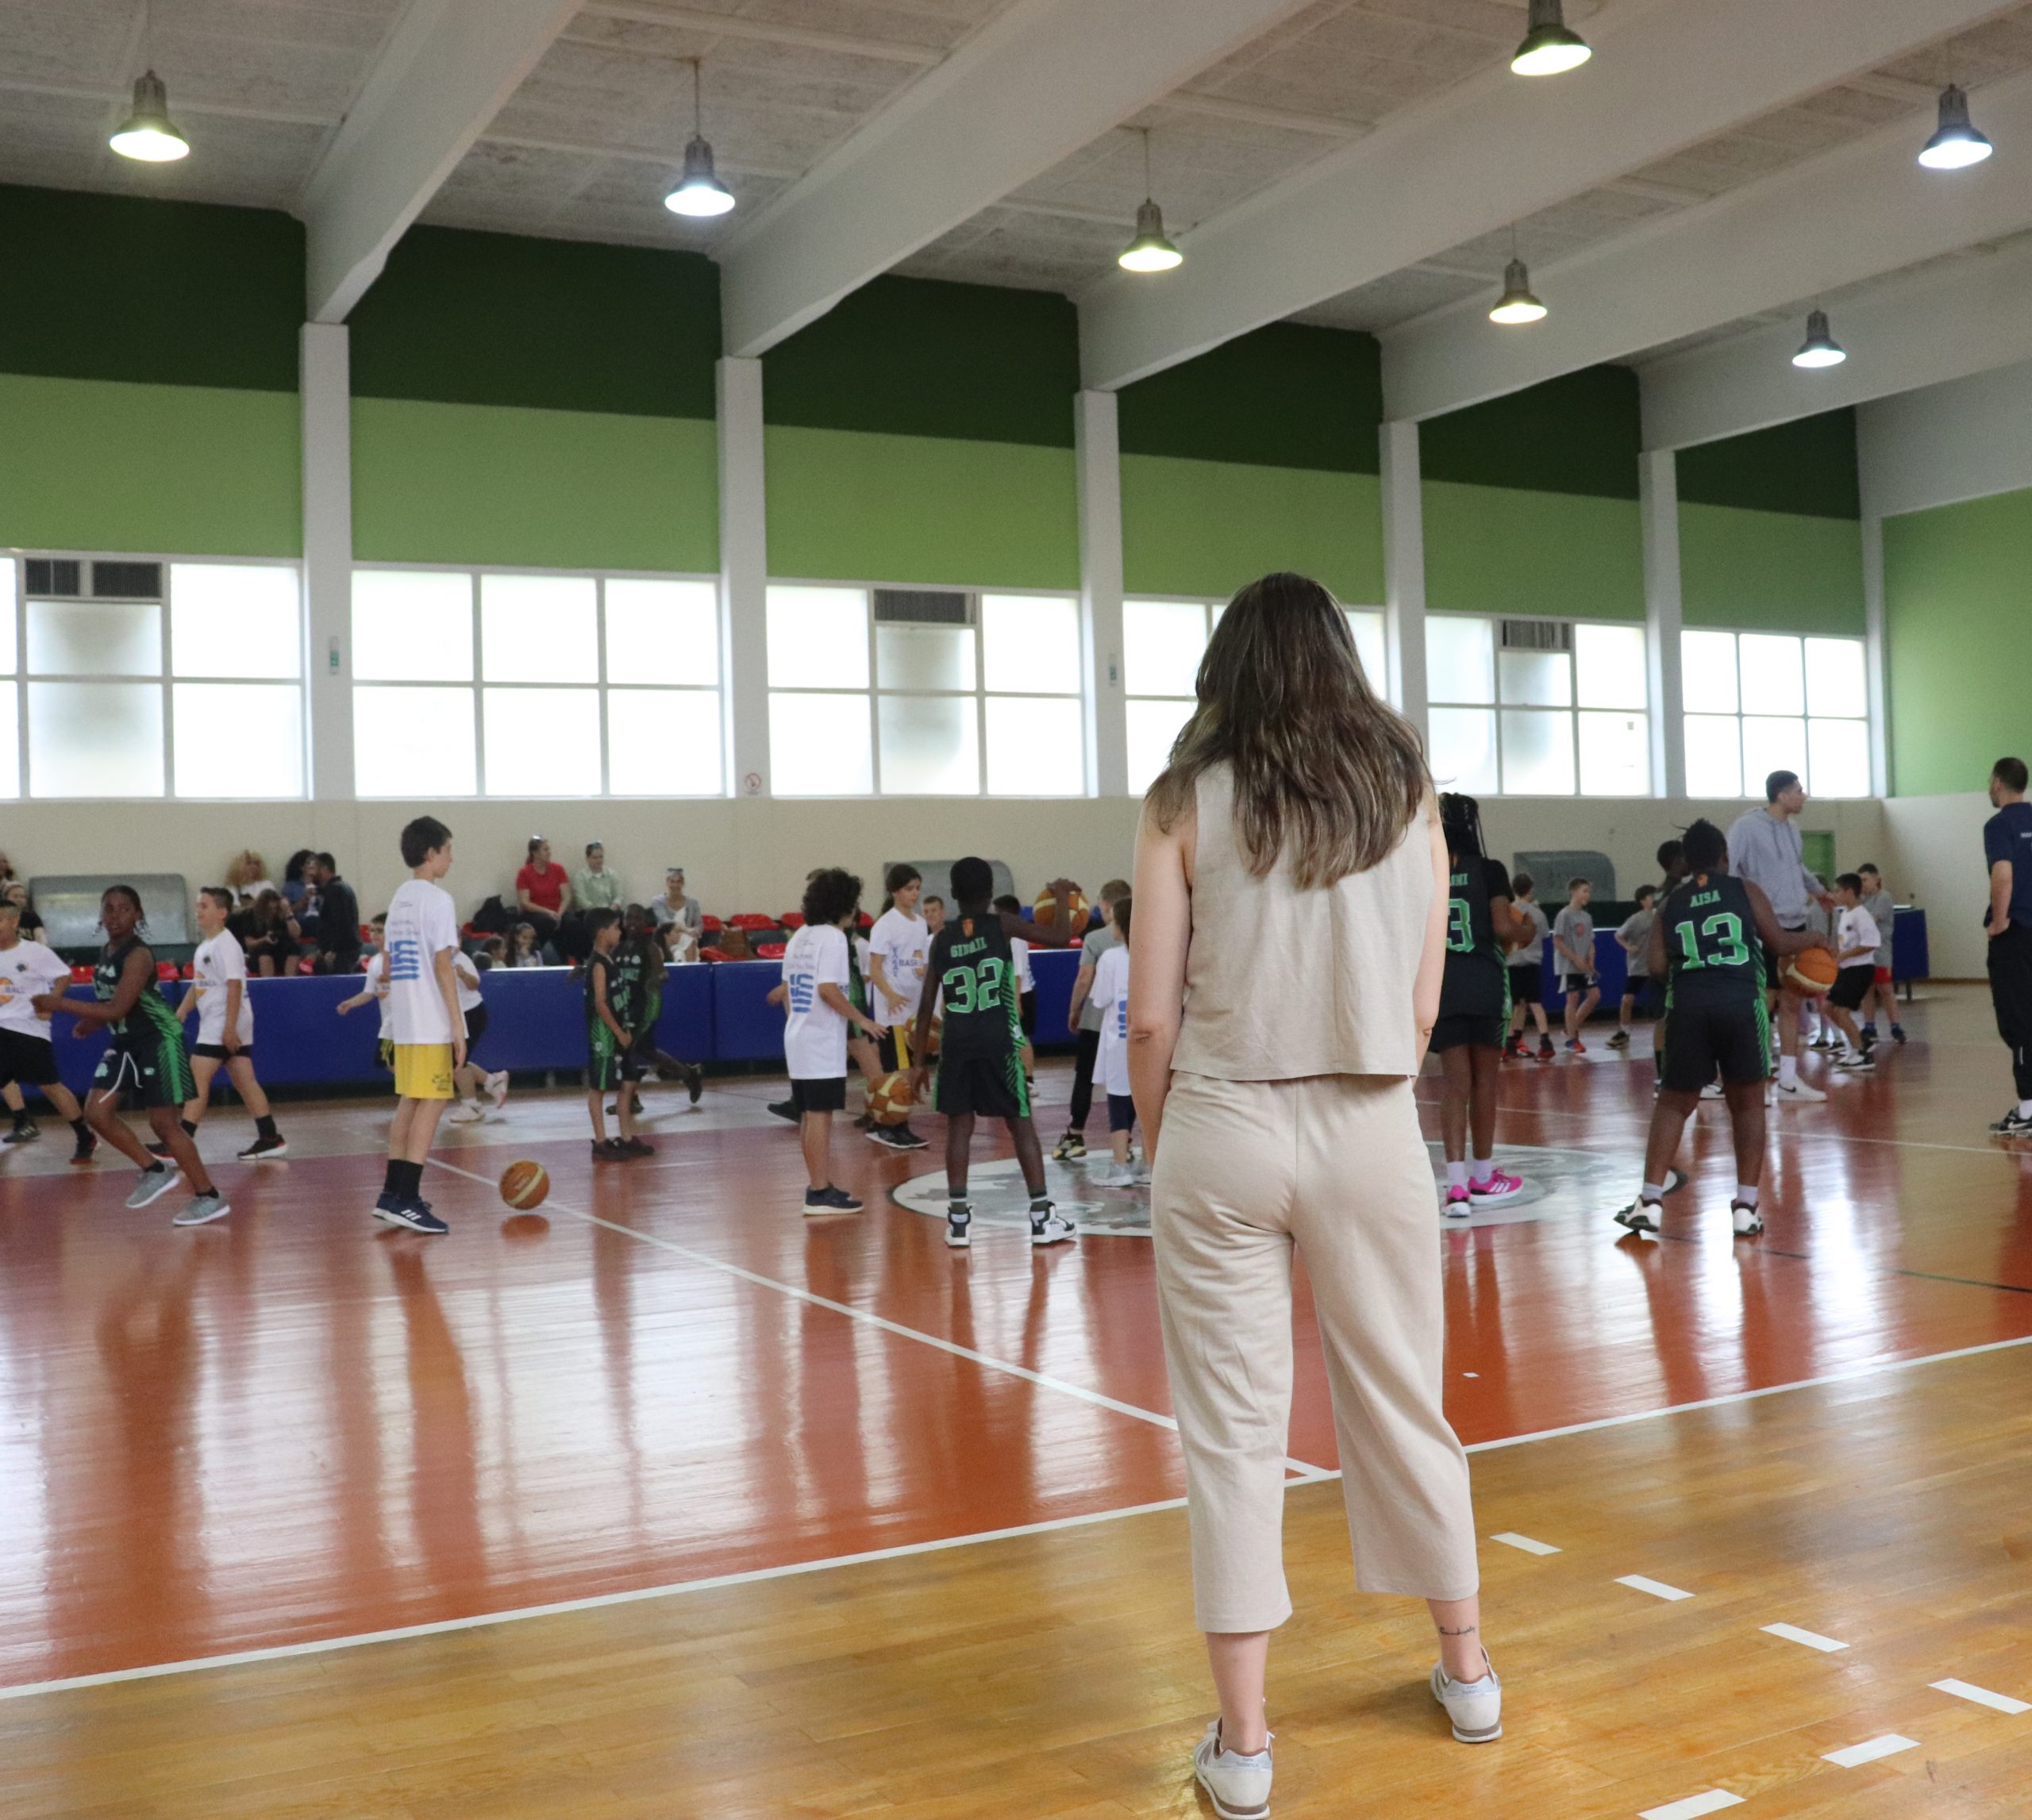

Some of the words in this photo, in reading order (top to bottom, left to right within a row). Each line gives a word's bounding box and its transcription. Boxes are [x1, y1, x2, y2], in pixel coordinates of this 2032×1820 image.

[1690, 890, 1722, 907] AISA
[1675, 912, 1749, 969] 13
[942, 957, 1004, 1013] 32
